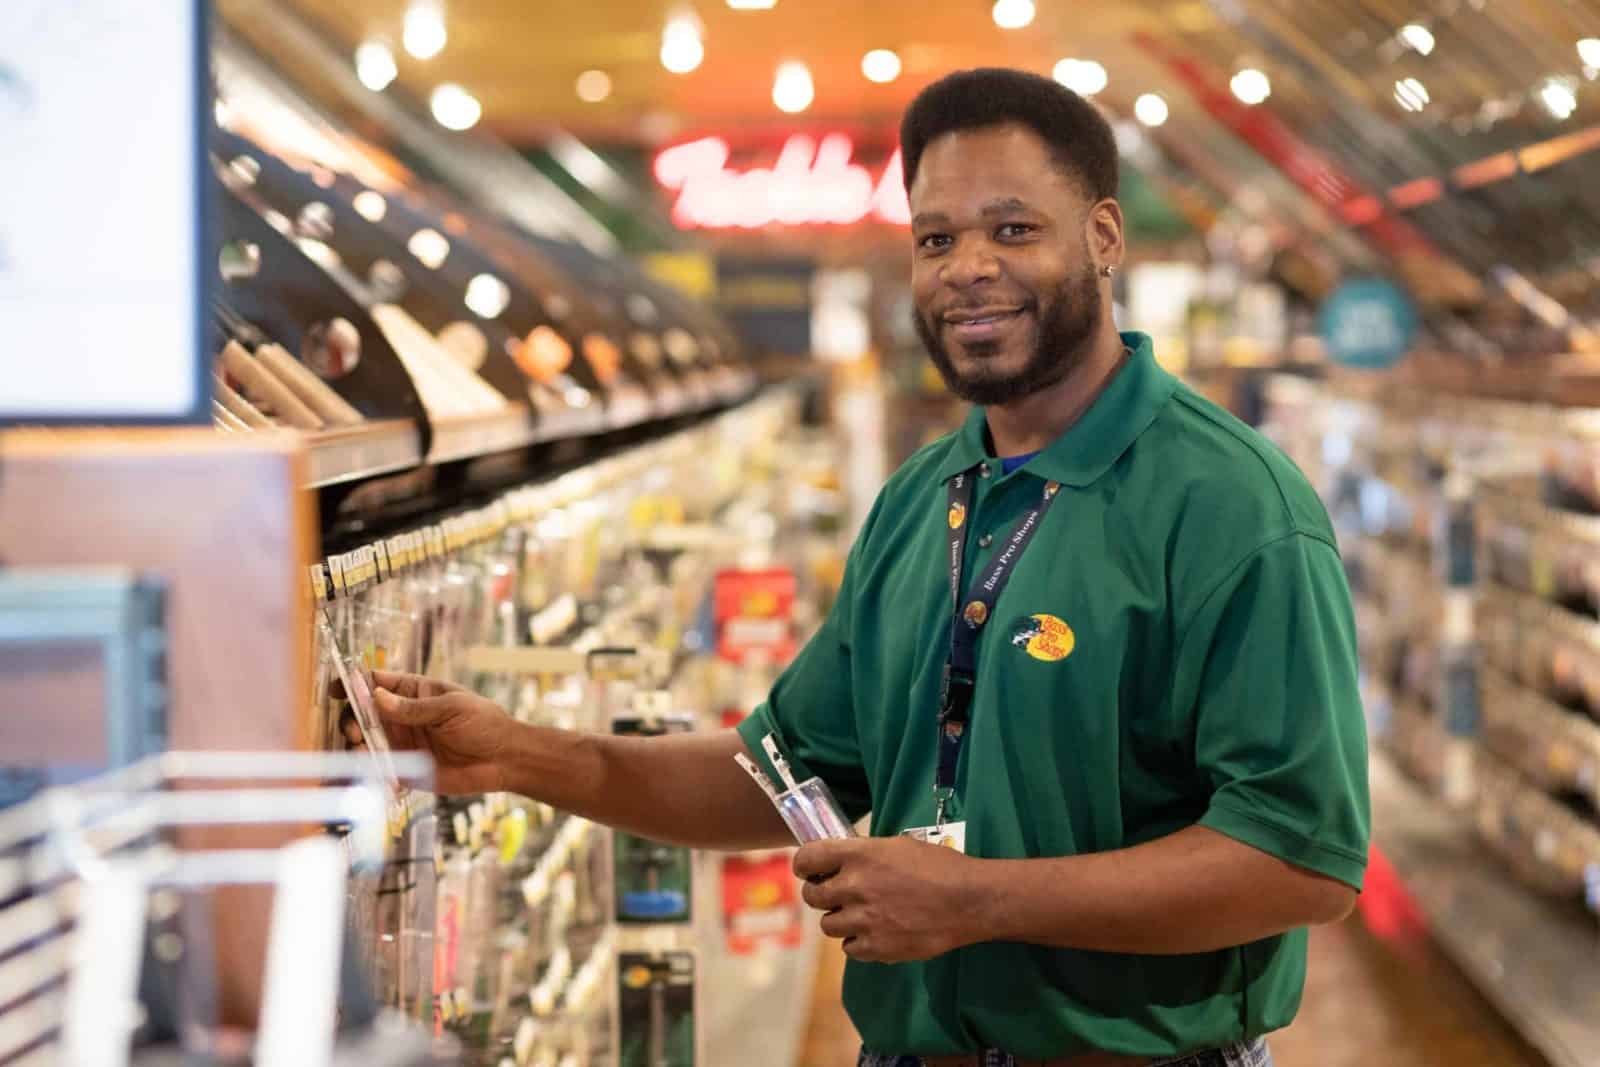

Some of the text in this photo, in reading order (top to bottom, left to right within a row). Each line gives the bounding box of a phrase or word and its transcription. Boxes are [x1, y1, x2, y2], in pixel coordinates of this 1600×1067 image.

[984, 511, 1038, 591] Bass Pro Shops
